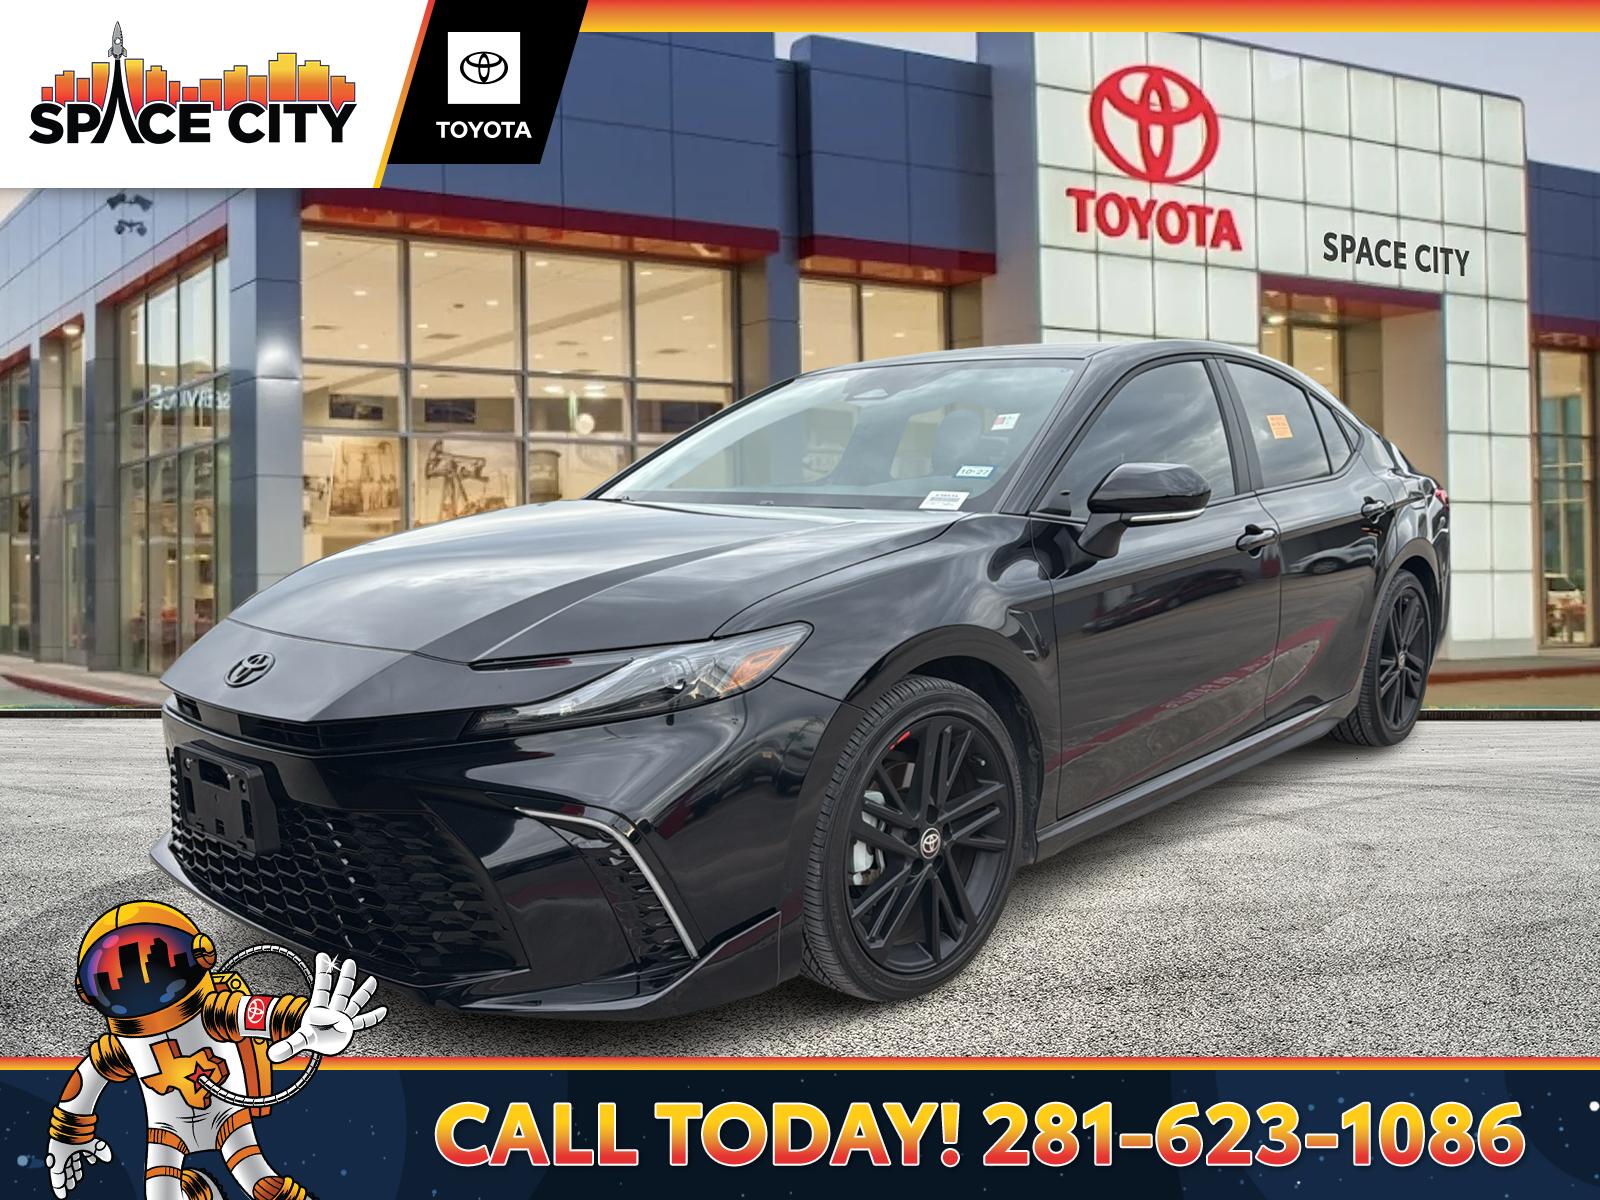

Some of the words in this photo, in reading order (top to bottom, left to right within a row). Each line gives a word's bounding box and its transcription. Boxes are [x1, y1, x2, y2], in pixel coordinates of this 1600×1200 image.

[1066, 187, 1242, 251] TOYOTA
[1323, 231, 1407, 270] SPACE
[1414, 244, 1470, 276] CITY
